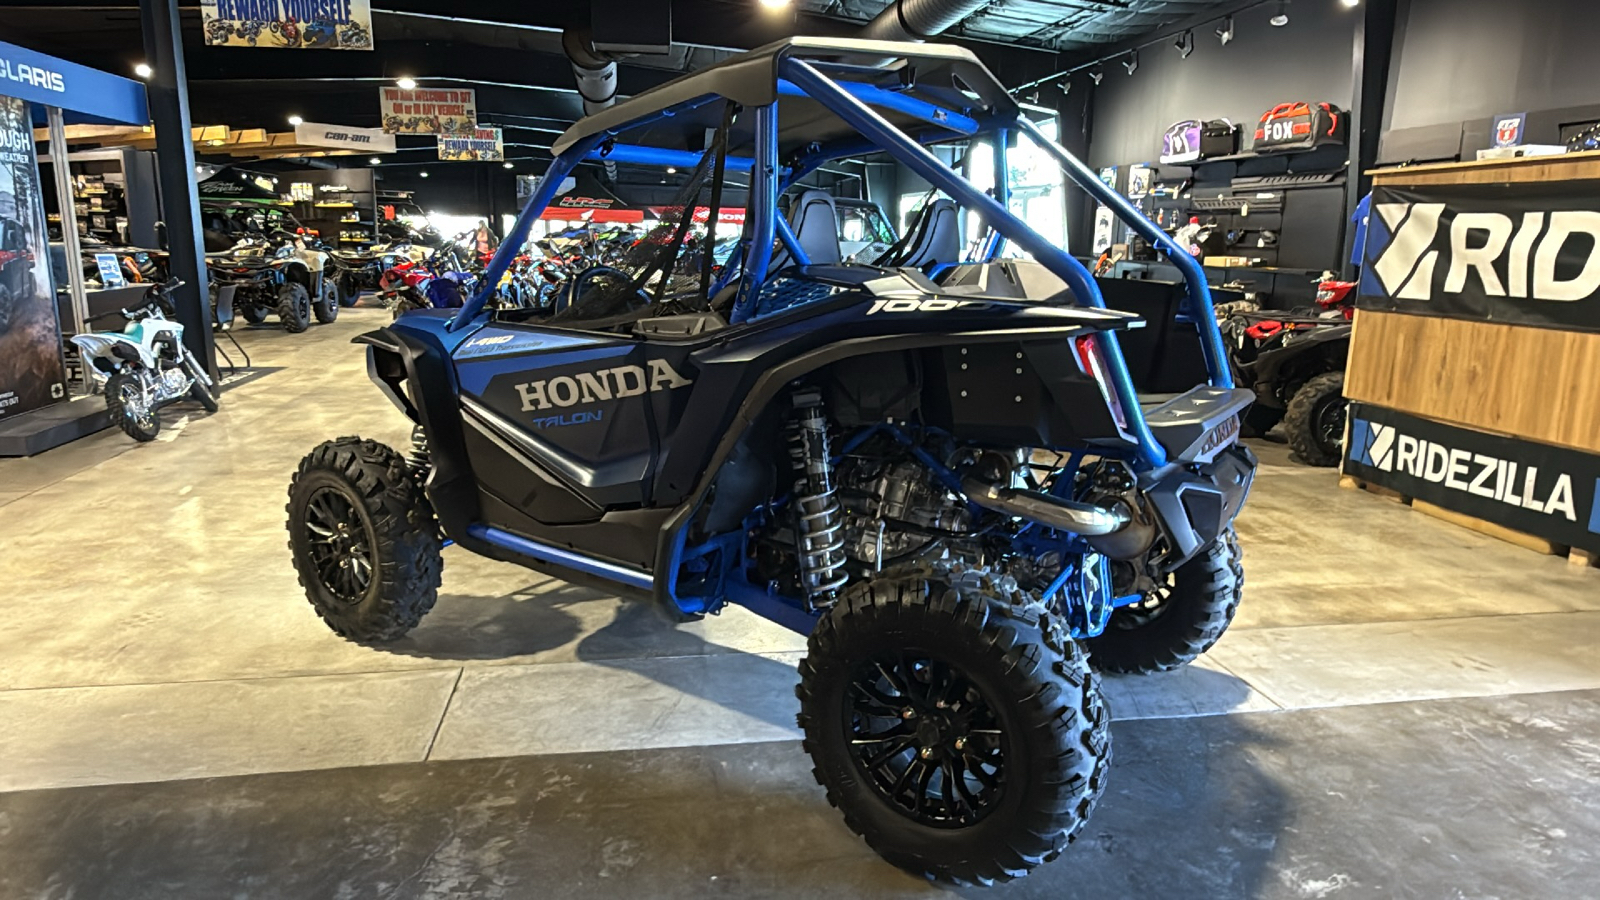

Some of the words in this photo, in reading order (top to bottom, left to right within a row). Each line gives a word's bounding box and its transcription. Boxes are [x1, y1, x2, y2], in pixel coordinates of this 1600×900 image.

[218, 0, 279, 22] REWARD
[281, 0, 352, 25] YOURSELF
[460, 92, 471, 103] SIT
[437, 104, 465, 116] VEHICLE
[325, 132, 370, 143] can-am
[1264, 121, 1293, 141] FOX
[1443, 210, 1600, 301] RID
[866, 299, 992, 316] 1000
[515, 358, 693, 412] HONDA
[533, 410, 603, 430] TALON
[1397, 434, 1577, 521] RIDEZILLA
